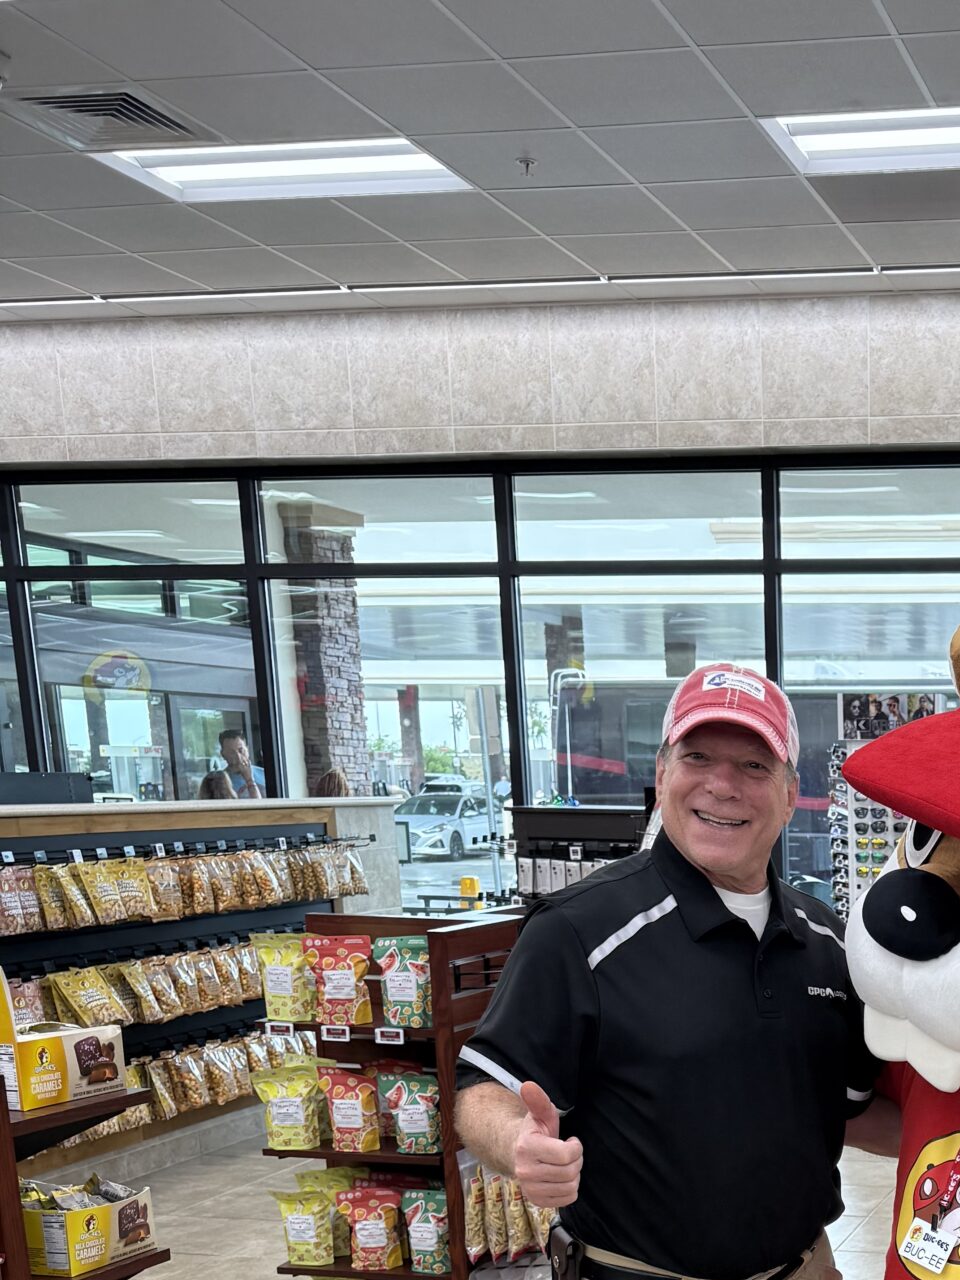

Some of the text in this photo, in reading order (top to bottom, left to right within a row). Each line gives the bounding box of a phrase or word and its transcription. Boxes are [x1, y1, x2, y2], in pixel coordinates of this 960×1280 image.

[76, 1244, 105, 1260] CARAMELS
[923, 1233, 950, 1252] BUC-EE'S
[904, 1242, 945, 1270] BUC-EE
